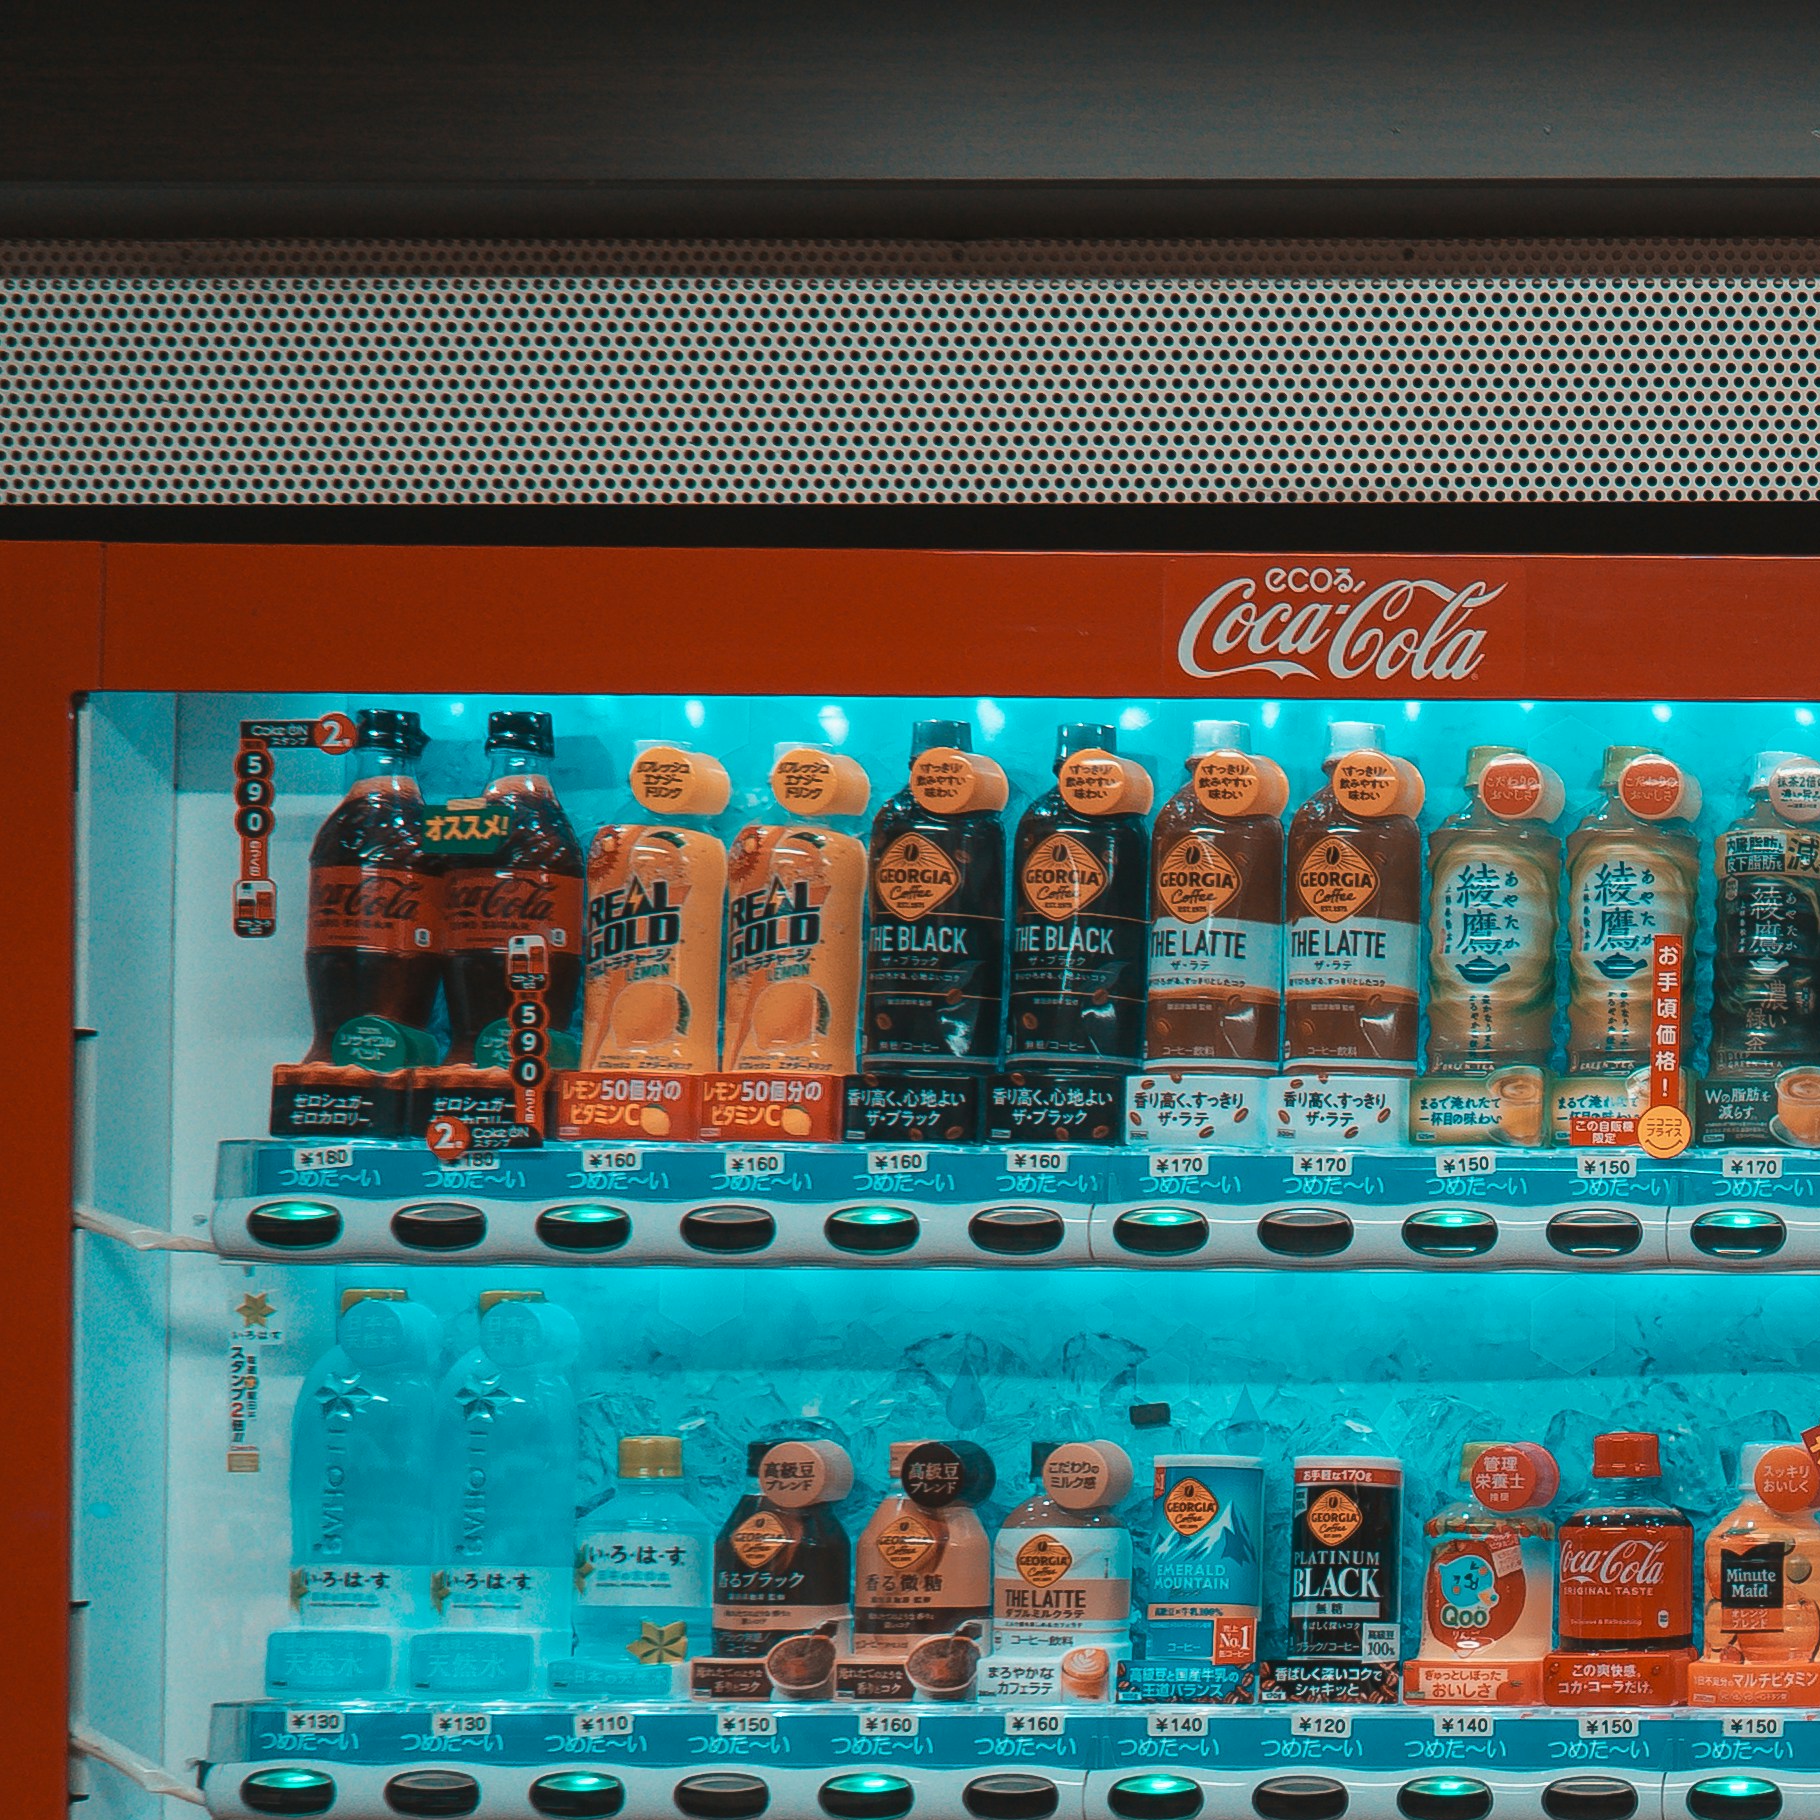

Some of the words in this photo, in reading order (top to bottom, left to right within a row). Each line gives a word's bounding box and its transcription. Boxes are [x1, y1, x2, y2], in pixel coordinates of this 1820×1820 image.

[1177, 577, 1508, 680] Coca-Cola
[425, 814, 509, 842] オススメ!
[879, 868, 955, 886] GEORGIA
[1457, 863, 1501, 954] 綾鷹
[905, 926, 966, 954] BLACK
[1291, 932, 1328, 958] THE
[1333, 932, 1387, 958] LATTE
[561, 1081, 682, 1103] レモン50個分の
[848, 1090, 966, 1108] 香り高く、心地よい
[1134, 1091, 1245, 1110] 香り高く、すっきり
[589, 1153, 635, 1169] ¥160
[1156, 1157, 1203, 1173] ¥170
[1293, 1567, 1380, 1599] BLACK
[1726, 1567, 1778, 1584] Minute
[1731, 1583, 1769, 1600] Maid
[1442, 1603, 1487, 1630] Qoo
[1274, 1666, 1383, 1684] 香ばしく深いコクで
[293, 1714, 340, 1730] ¥130
[580, 1716, 628, 1732] ¥110
[1155, 1717, 1203, 1733] ¥140
[1300, 1718, 1347, 1734] ¥120
